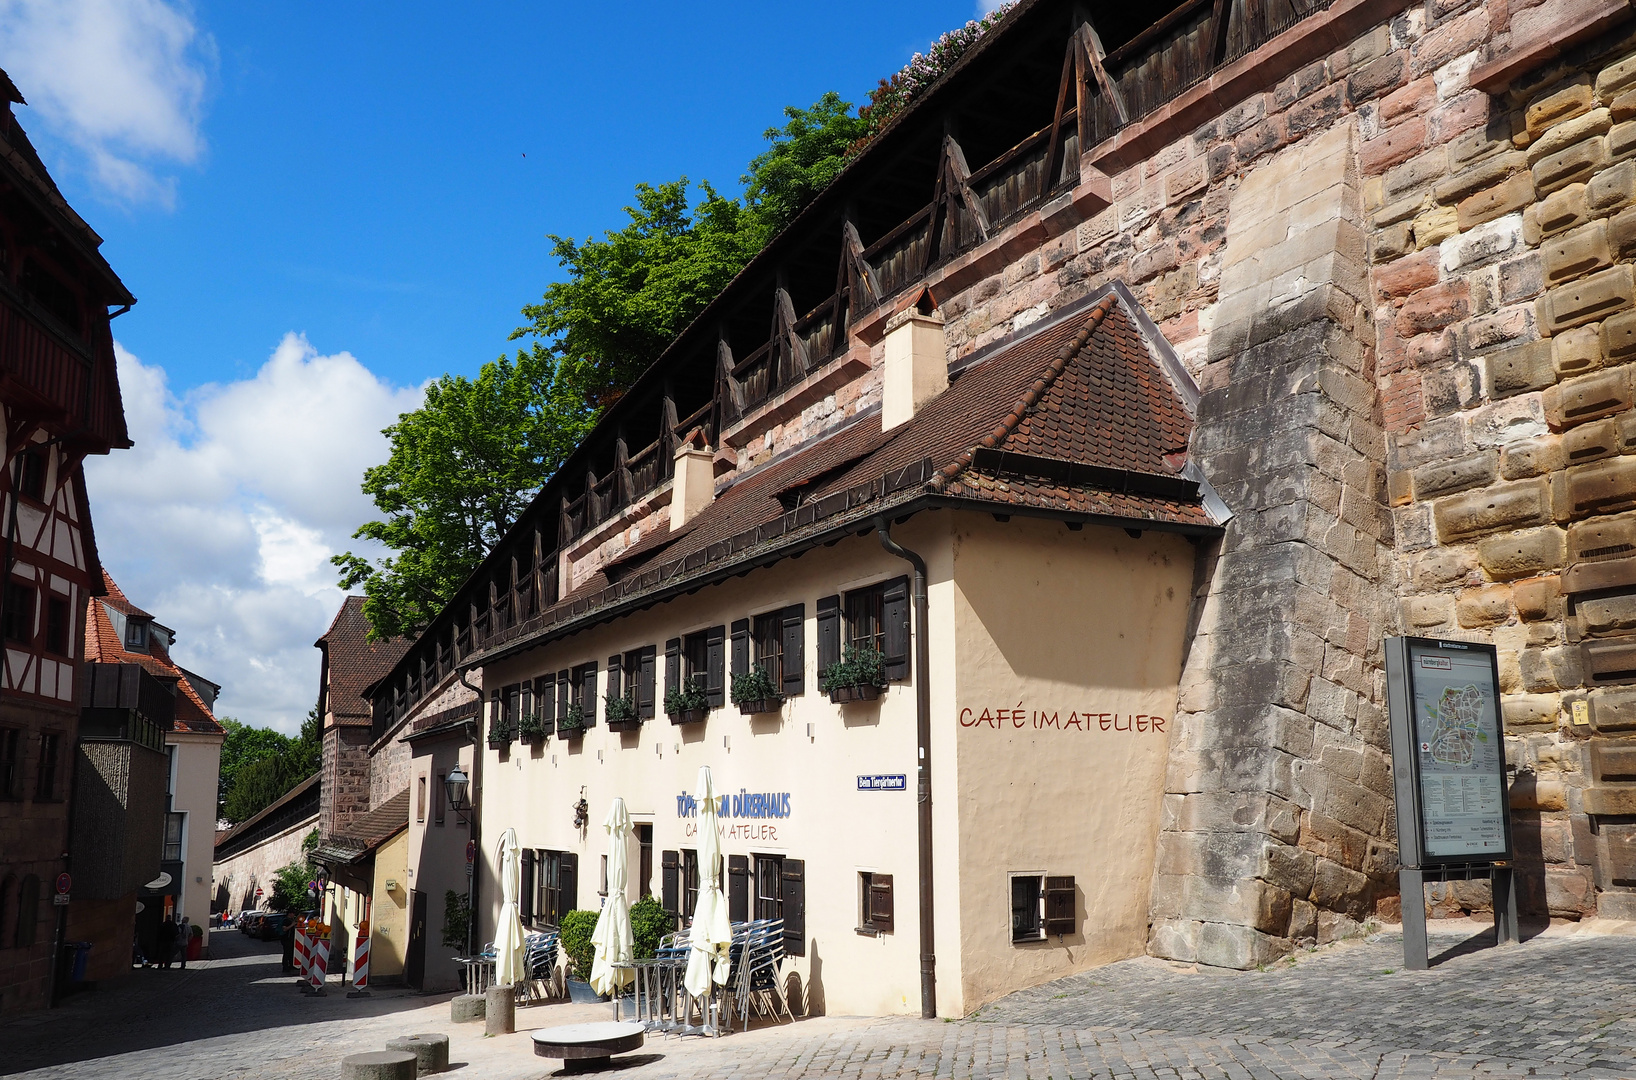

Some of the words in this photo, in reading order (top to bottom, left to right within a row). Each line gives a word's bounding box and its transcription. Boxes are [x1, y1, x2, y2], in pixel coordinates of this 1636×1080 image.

[960, 701, 1026, 729] CAFÉ
[1033, 711, 1060, 730] IM
[1064, 711, 1166, 733] ATELIER
[859, 777, 870, 787] Beim
[733, 788, 791, 819] DÜRERHAUS
[728, 824, 778, 841] ATELIER
